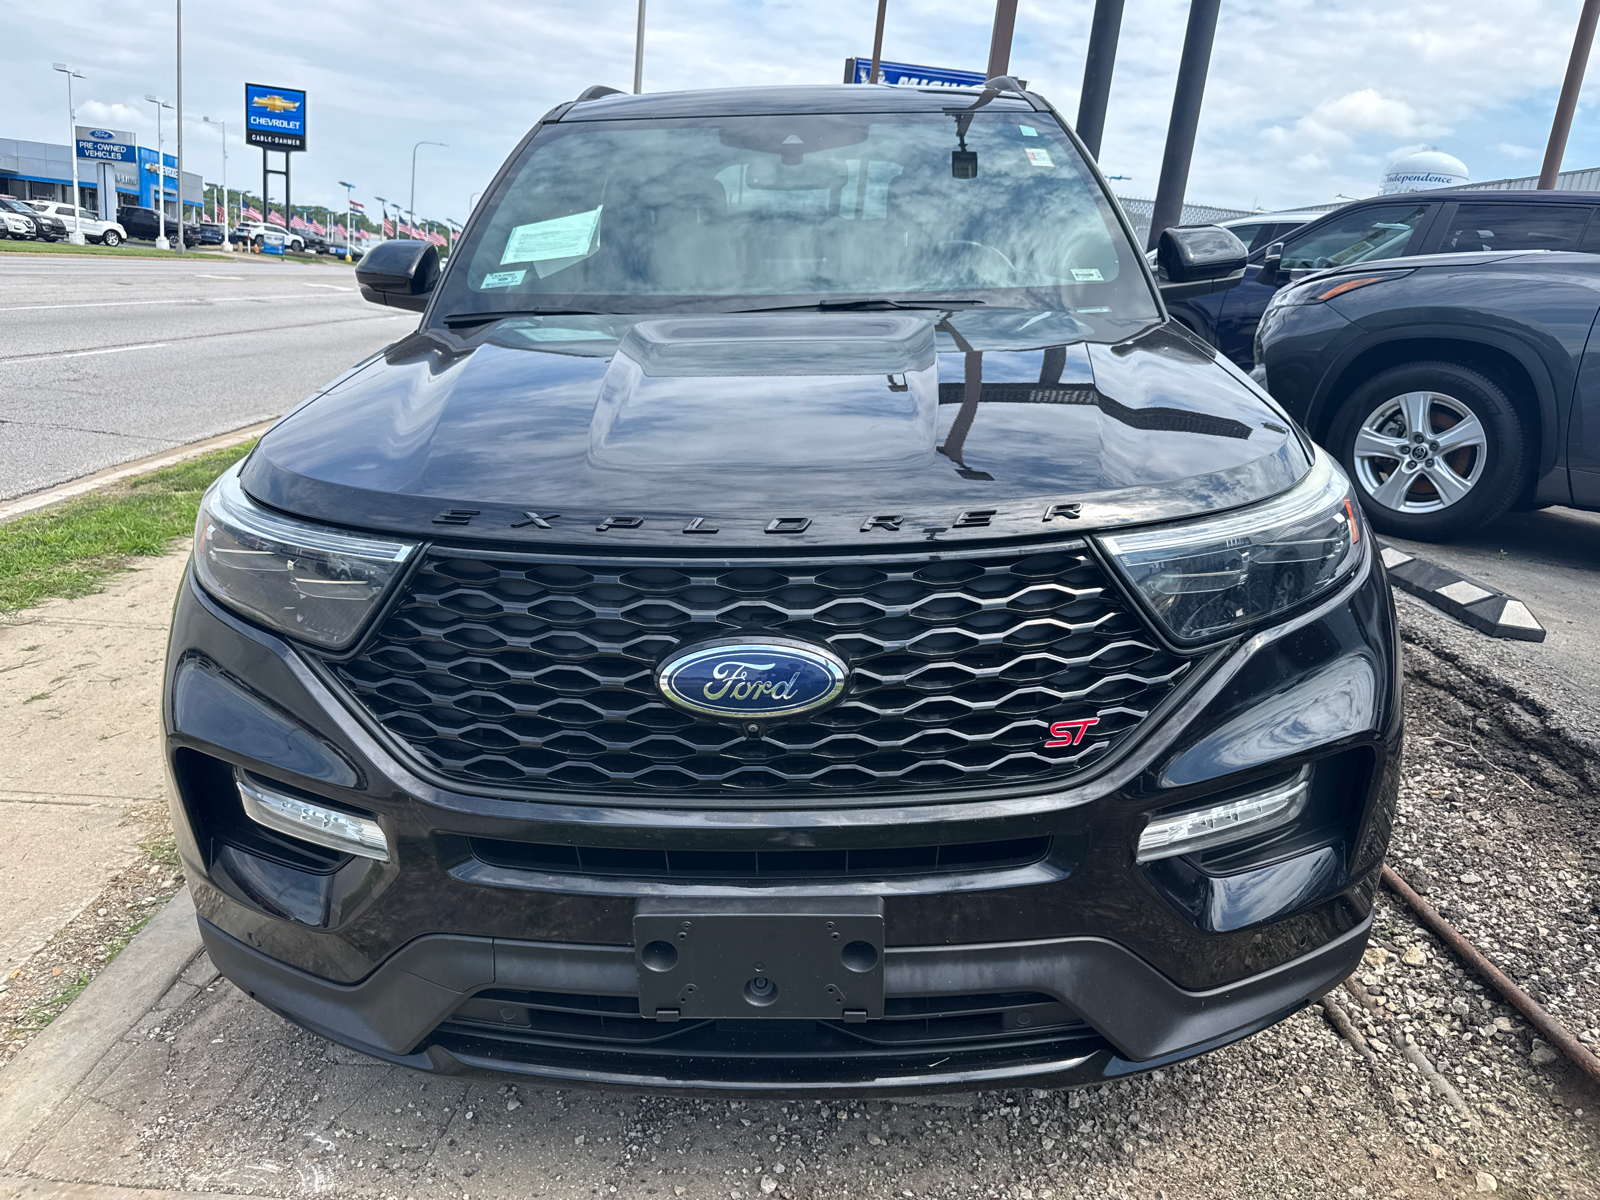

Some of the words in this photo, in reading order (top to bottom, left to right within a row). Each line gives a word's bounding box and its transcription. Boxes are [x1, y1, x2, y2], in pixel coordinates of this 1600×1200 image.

[250, 116, 301, 130] CHEVROLET
[251, 134, 300, 146] CABLE-DAHMER
[84, 149, 122, 160] VEHICLES
[1385, 172, 1453, 184] Independence
[1443, 374, 1500, 413] MICHELIN
[431, 502, 1083, 534] EXPLORER
[703, 661, 801, 701] Ford
[1044, 717, 1100, 748] ST
